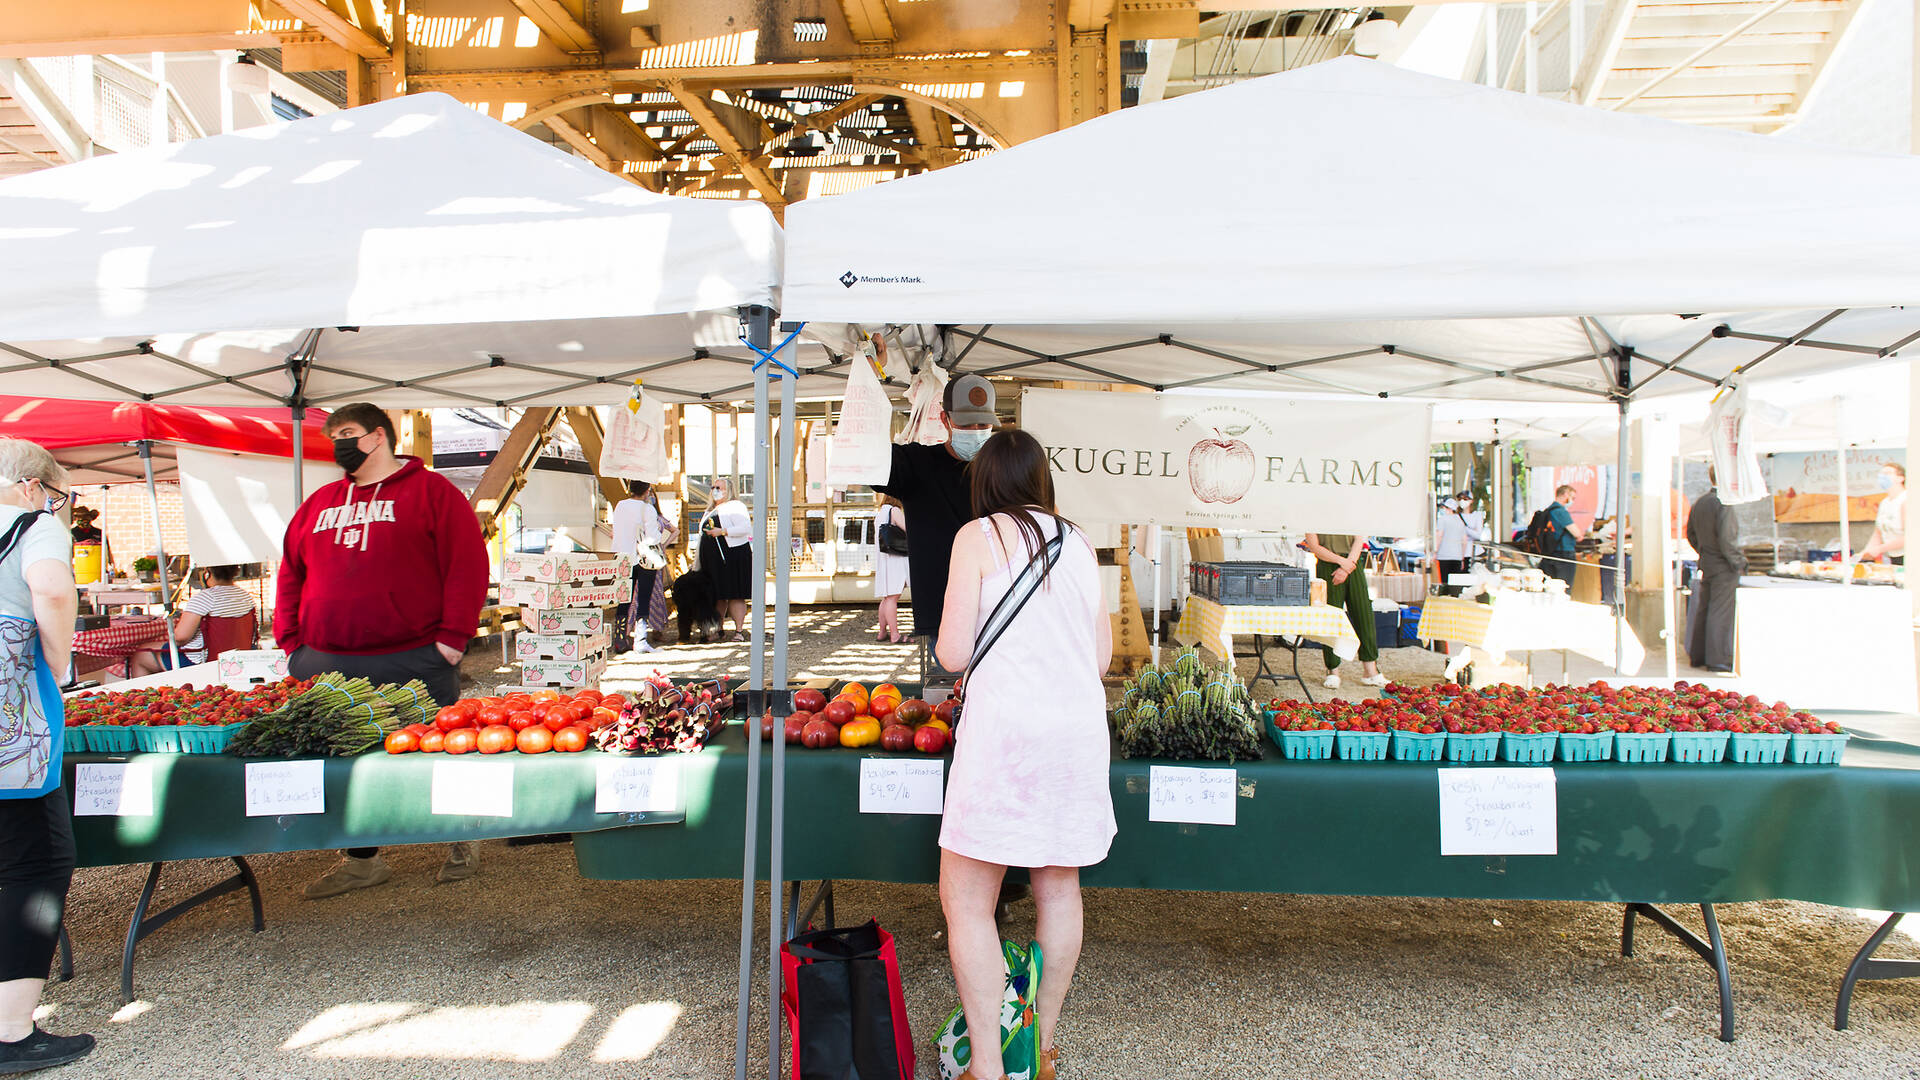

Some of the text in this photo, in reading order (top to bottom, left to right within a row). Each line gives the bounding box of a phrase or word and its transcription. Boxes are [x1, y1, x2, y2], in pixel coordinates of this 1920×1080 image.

[860, 275, 921, 284] Member's Mark
[1045, 446, 1403, 488] KUGEL FARMS
[312, 500, 396, 534] INDIANA
[1152, 769, 1193, 786] Asparagus
